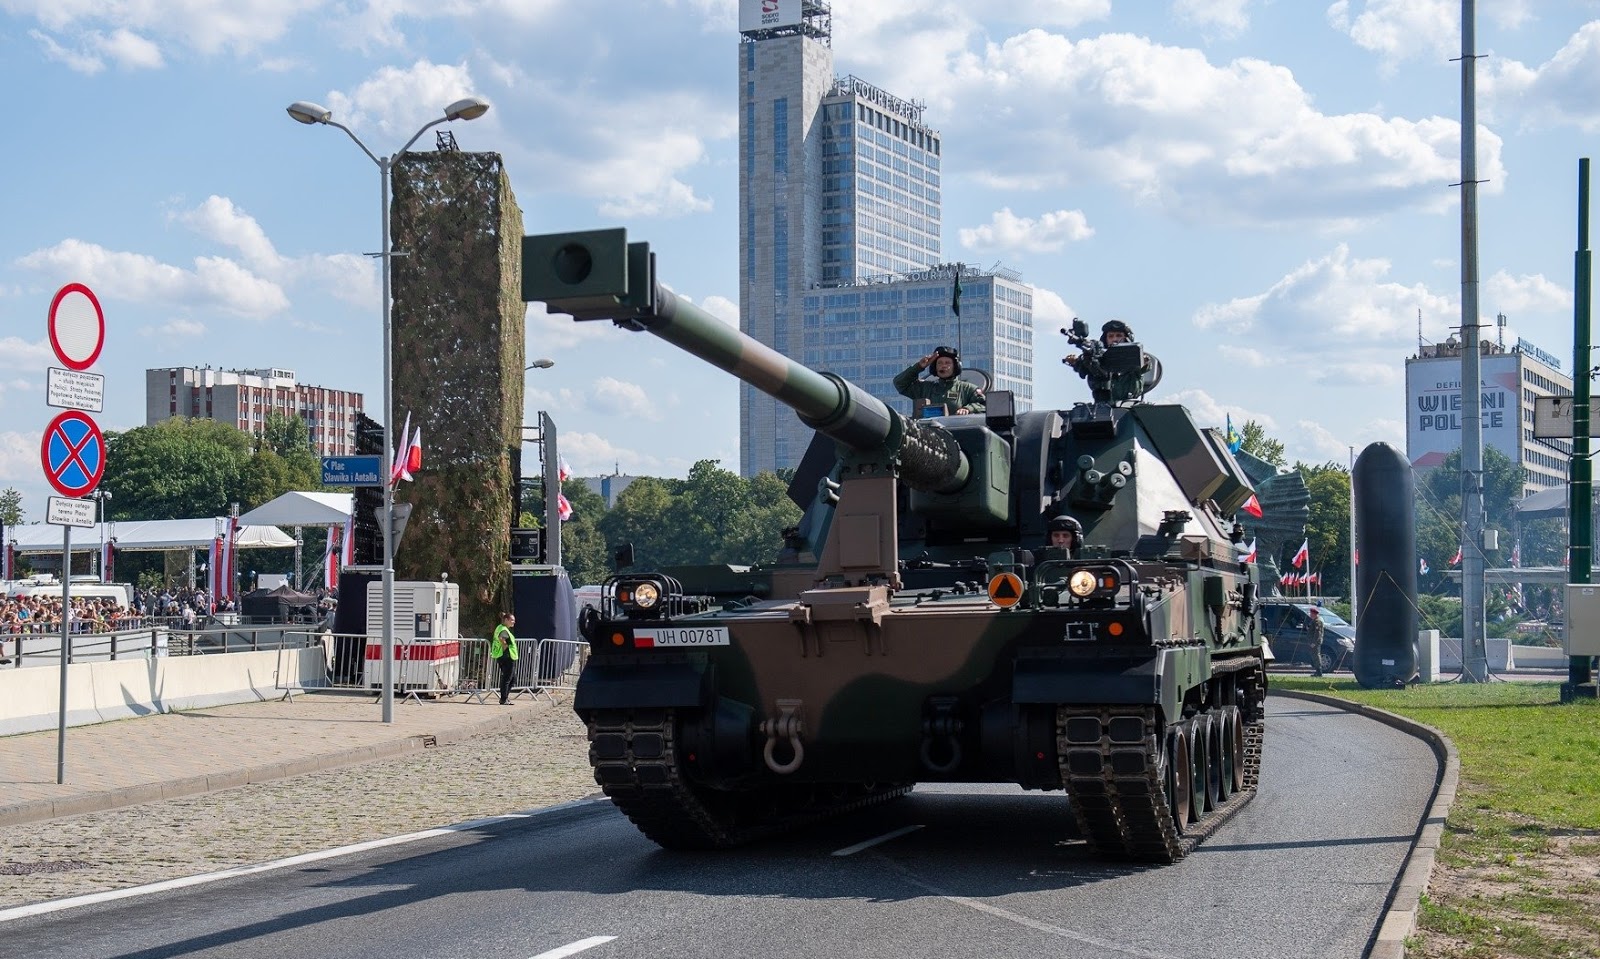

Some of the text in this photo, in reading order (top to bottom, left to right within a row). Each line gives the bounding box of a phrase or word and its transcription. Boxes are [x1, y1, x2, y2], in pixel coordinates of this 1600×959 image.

[853, 80, 920, 122] COURTYARD
[1436, 380, 1486, 389] DEFILA
[1418, 392, 1504, 412] WIENI
[1420, 411, 1503, 431] POLCE
[331, 461, 345, 470] Plac
[355, 472, 377, 482] Antalla
[657, 629, 722, 644] UH 0078T
